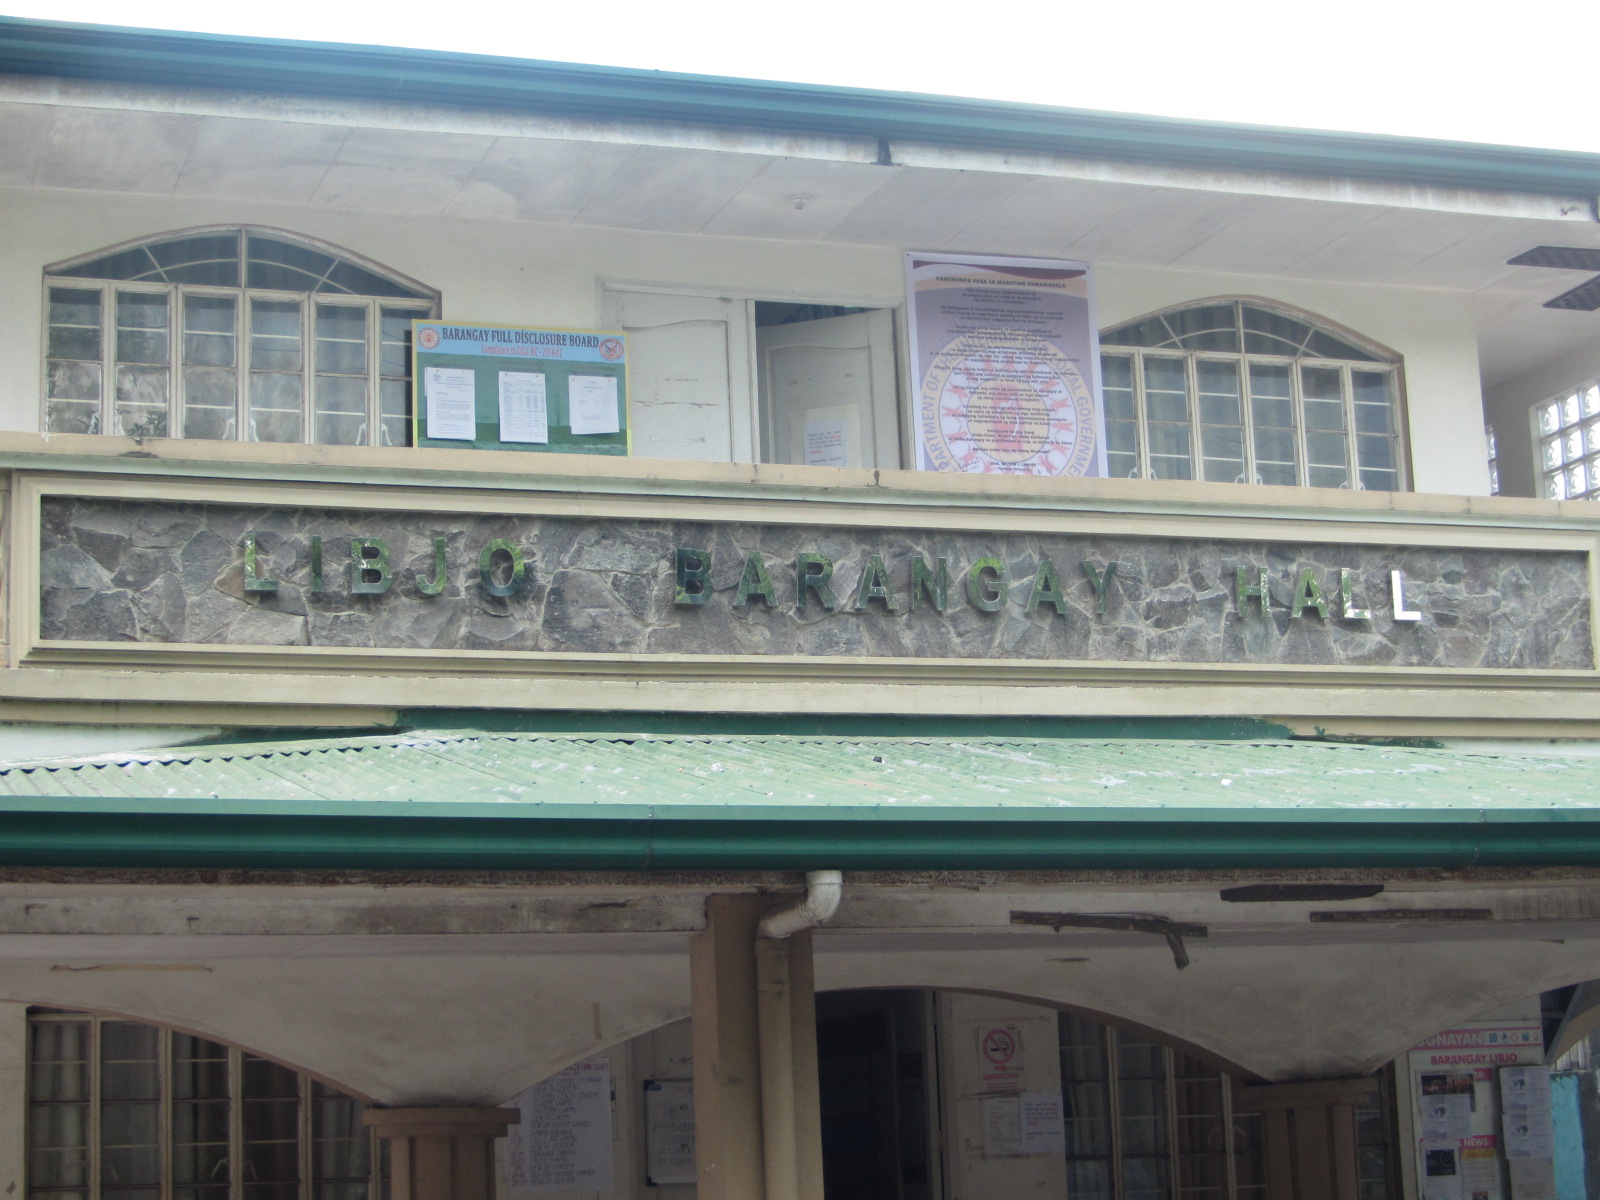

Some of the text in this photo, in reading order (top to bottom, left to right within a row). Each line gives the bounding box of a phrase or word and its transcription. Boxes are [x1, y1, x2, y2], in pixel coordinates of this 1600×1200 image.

[442, 327, 599, 348] BARANGAY FULL DISCLOSURE BOARD
[926, 372, 941, 391] OF
[922, 392, 958, 472] PARTMENT
[1066, 396, 1093, 477] GOVERNME
[244, 533, 1422, 621] LIBJO BARANGAY HALL
[994, 1064, 1007, 1072] NO
[1430, 1053, 1518, 1066] BARANGAY LIBJO
[982, 1072, 1020, 1081] SMOKING
[1463, 1137, 1489, 1146] NEWS
